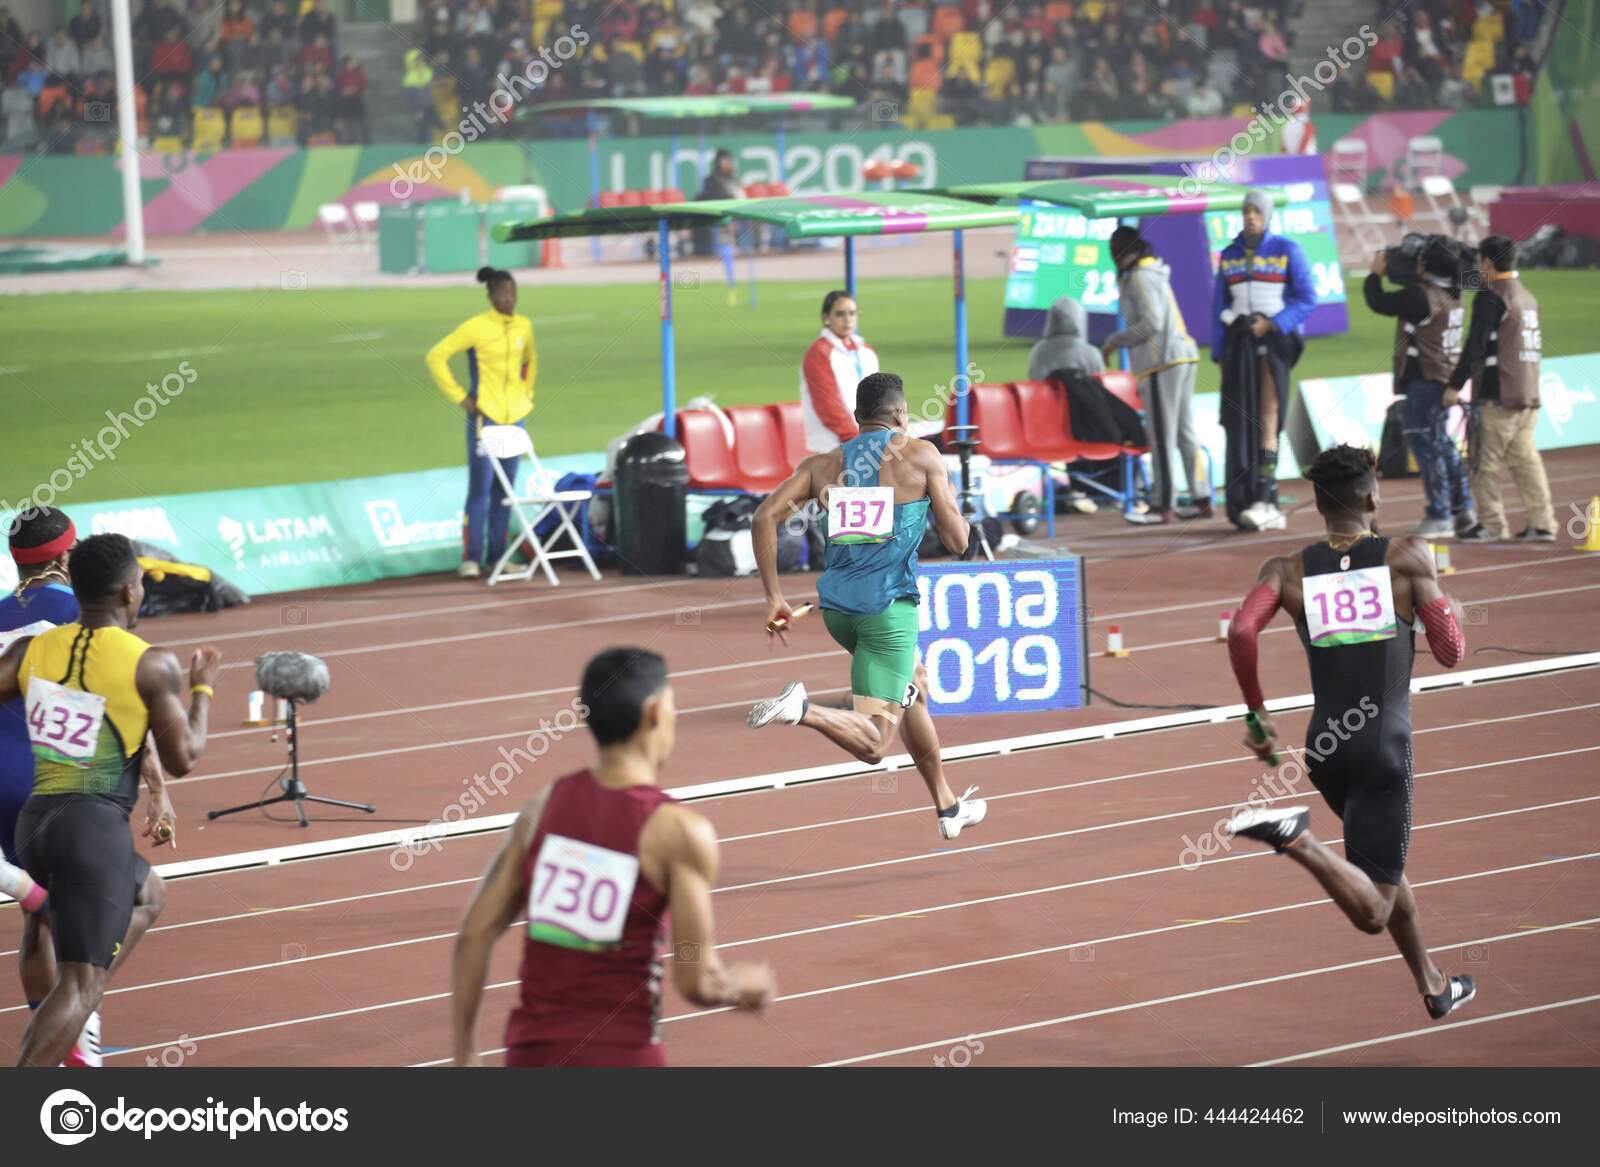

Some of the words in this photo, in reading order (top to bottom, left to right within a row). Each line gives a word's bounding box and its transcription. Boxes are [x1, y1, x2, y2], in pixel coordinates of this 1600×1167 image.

[248, 514, 334, 544] LATAM
[836, 500, 886, 528] 137
[260, 545, 344, 568] AIRLINES
[918, 570, 1059, 630] ima
[1312, 585, 1382, 625] 183
[916, 634, 1062, 704] 019
[29, 702, 93, 747] 432
[537, 862, 620, 923] 730
